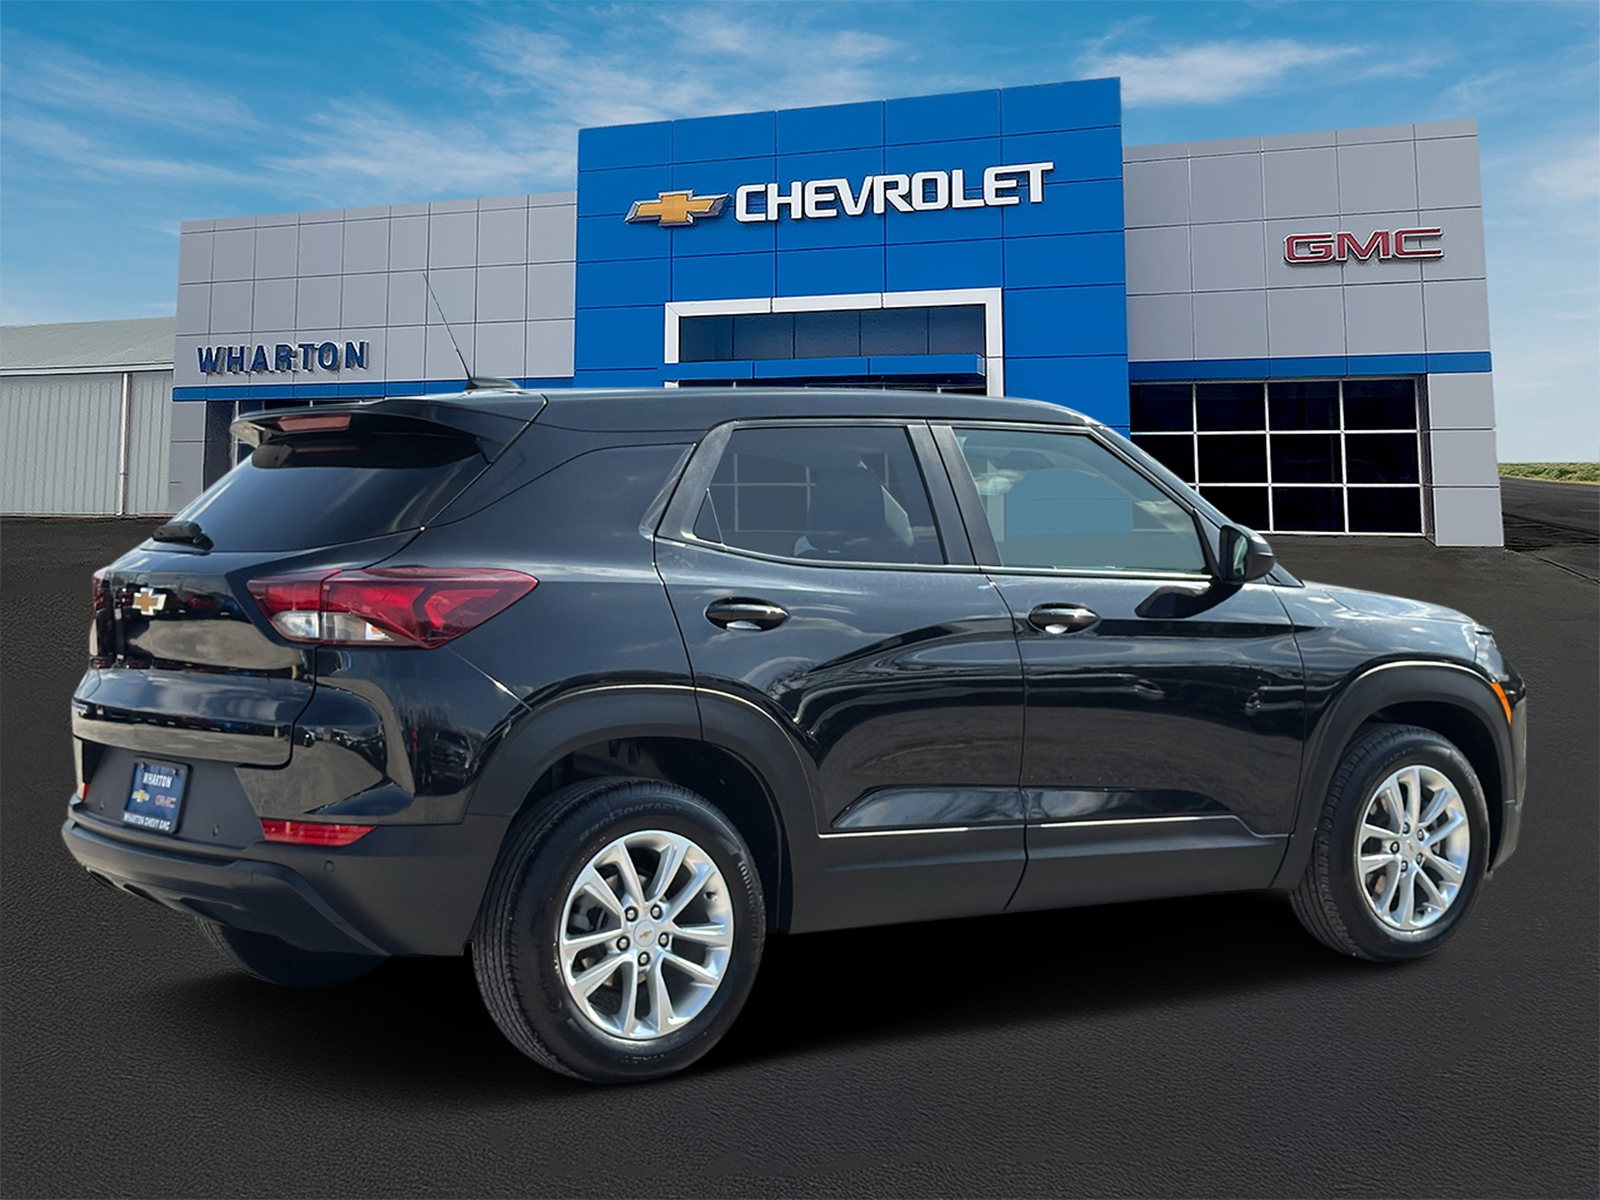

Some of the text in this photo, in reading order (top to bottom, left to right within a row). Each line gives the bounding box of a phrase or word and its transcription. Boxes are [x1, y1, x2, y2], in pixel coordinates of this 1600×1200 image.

[734, 162, 1054, 222] CHEVROLET
[1284, 227, 1443, 263] GMC
[197, 341, 369, 373] WHARTON
[143, 772, 172, 788] WHARTON
